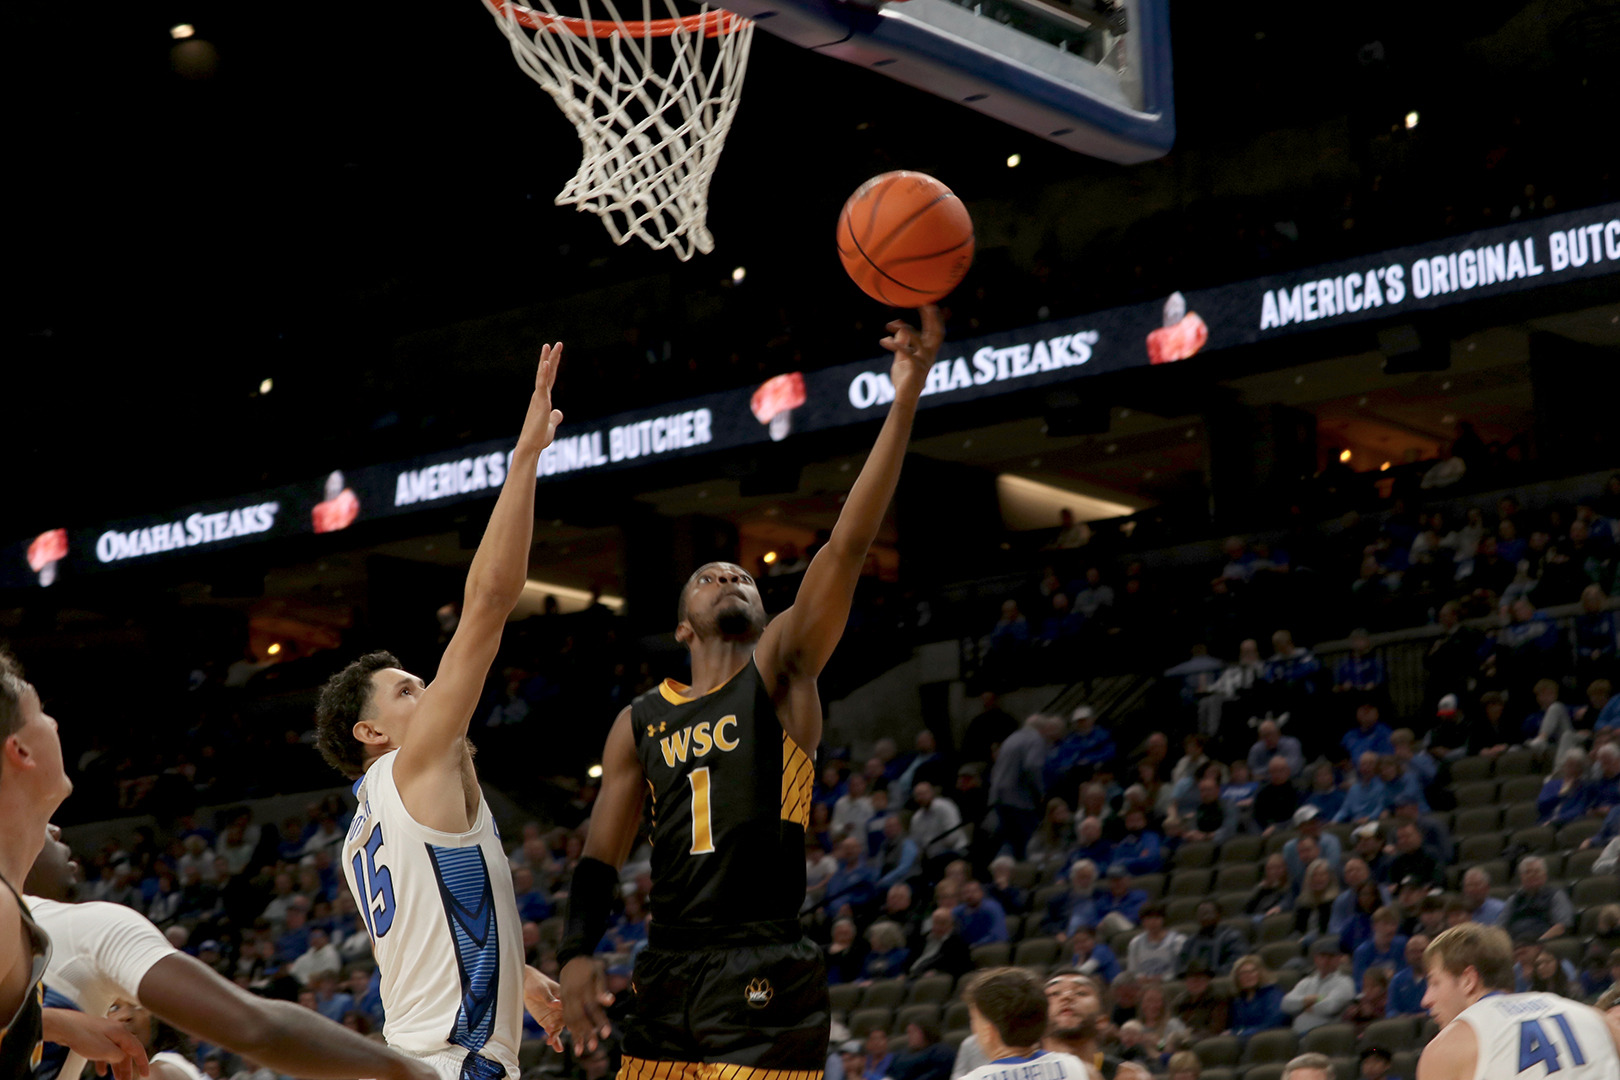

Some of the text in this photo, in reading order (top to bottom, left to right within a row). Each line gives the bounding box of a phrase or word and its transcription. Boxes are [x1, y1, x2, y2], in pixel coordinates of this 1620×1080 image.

[1260, 263, 1405, 331] AMERICA'S
[1410, 237, 1544, 299] ORIGINAL
[848, 356, 973, 409] OMHA
[394, 450, 505, 506] AMERICA'S
[609, 407, 712, 463] BUTCHER
[96, 521, 186, 563] OMAHA
[660, 714, 740, 768] WSC
[687, 766, 716, 855] 1
[352, 821, 396, 947] 15
[1516, 1013, 1587, 1076] 41
